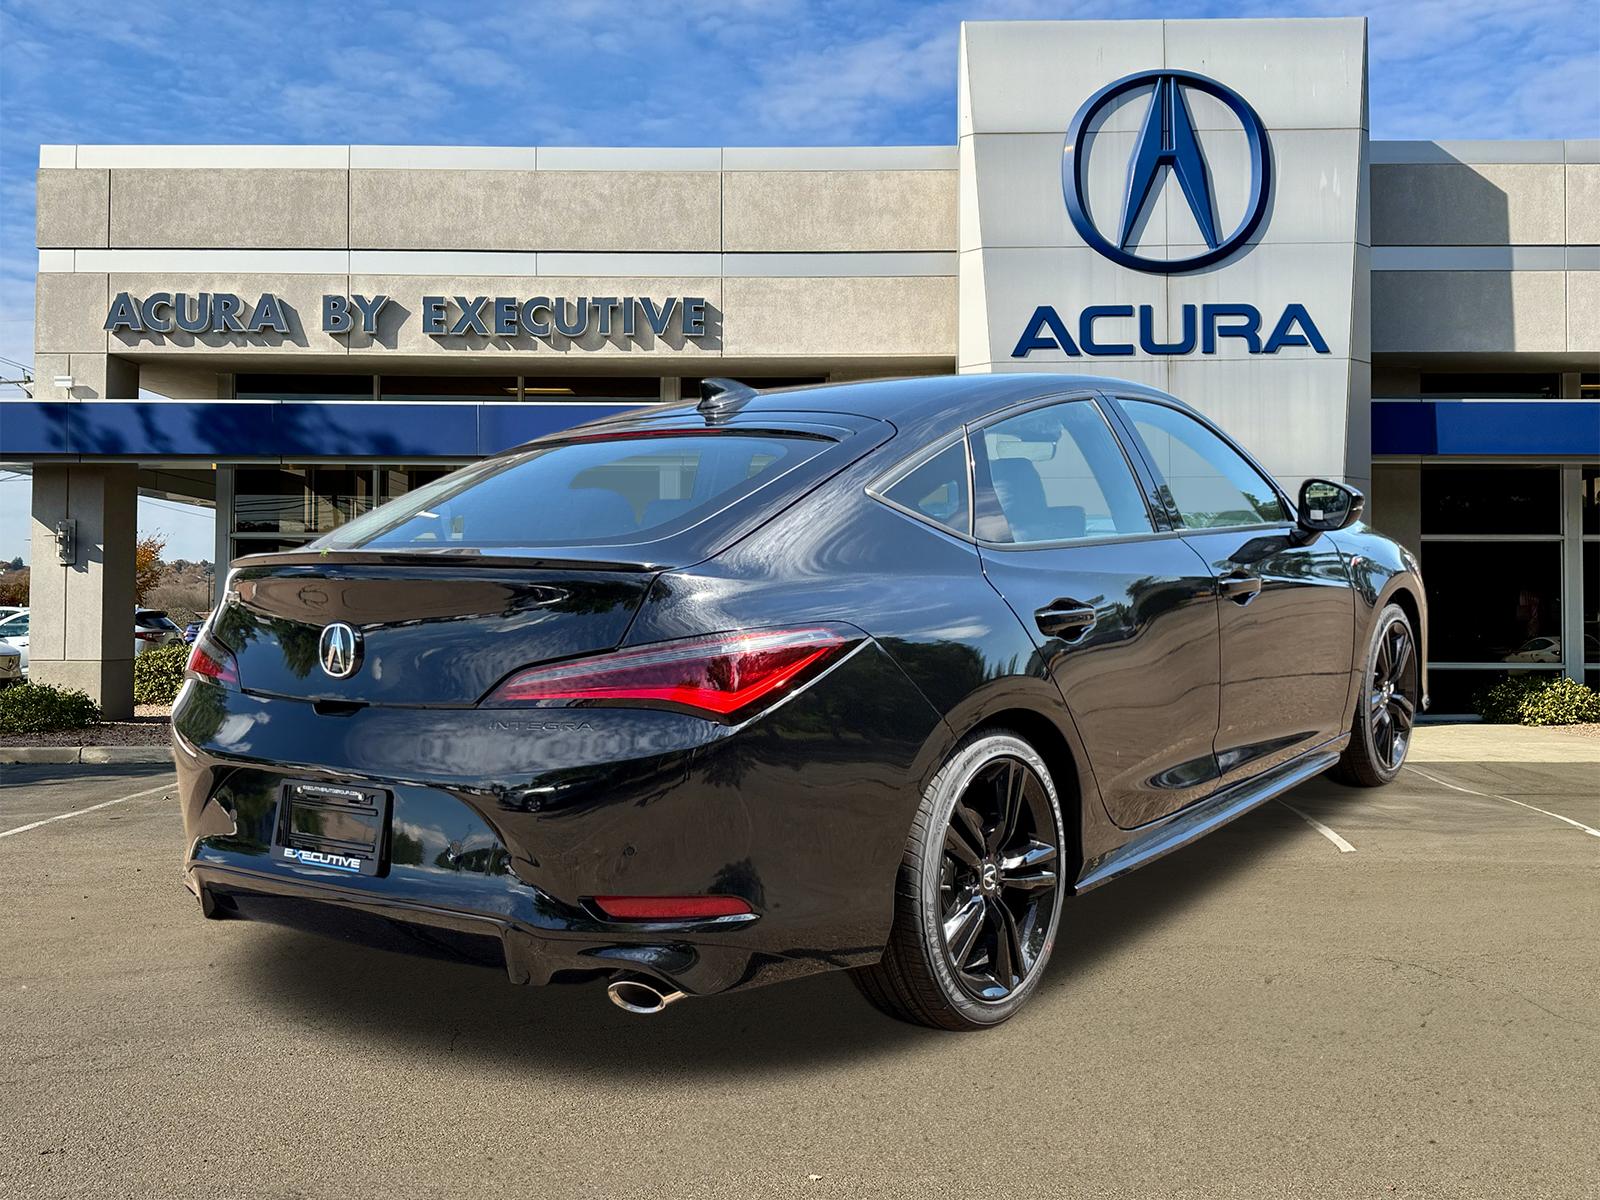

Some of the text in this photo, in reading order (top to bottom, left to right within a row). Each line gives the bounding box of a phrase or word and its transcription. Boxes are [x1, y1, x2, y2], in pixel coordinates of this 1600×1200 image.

[103, 291, 708, 337] ACURA BY EXECUTIVE
[1010, 303, 1331, 357] ACURA
[488, 720, 594, 732] INTEGRA
[283, 847, 361, 869] EXECUTIVE
